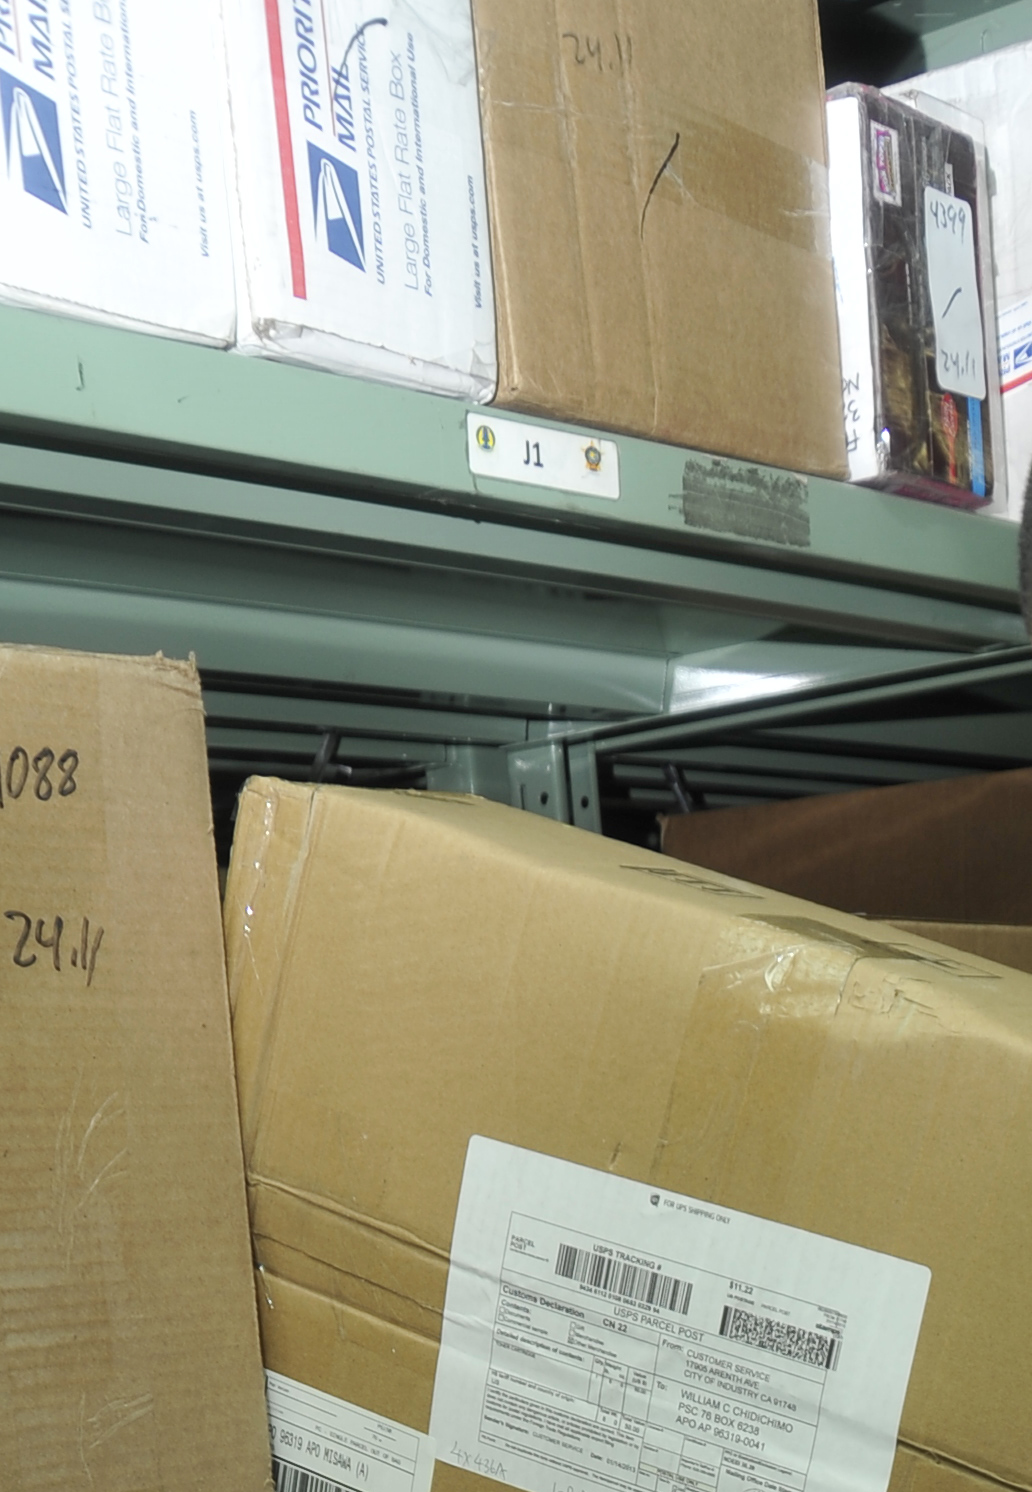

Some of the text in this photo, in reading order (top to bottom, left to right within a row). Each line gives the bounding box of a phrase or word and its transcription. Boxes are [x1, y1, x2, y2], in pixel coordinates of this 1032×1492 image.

[60, 19, 78, 91] POSTAL
[99, 33, 118, 97] Rate
[69, 92, 85, 159] STATES
[103, 105, 125, 153] Flat
[126, 98, 139, 131] and
[332, 62, 358, 153] MAIL
[364, 96, 375, 161] POSTAL
[131, 135, 146, 213] Domestic
[189, 109, 209, 258] Visit us at usps.com
[389, 50, 420, 292] Large Flat Rate Box
[407, 32, 433, 298] For Domestic and International Use
[76, 159, 92, 230] UNITED
[113, 162, 133, 238] Large
[368, 160, 380, 221] STATES
[467, 175, 483, 310] Visit us at usps.com
[929, 200, 966, 244] 4399
[373, 220, 385, 285] UNITED
[940, 349, 976, 381] 24.11
[523, 440, 544, 468] J1
[0, 746, 79, 806] 088
[664, 1199, 730, 1225] FOR UPS SHIPPING ONLY
[510, 1241, 527, 1251] POST
[511, 1234, 536, 1248] PARCEL
[593, 1243, 613, 1256] USPS
[616, 1251, 655, 1269] TRACKING
[502, 1284, 628, 1333] Customs Declaration CN 22
[729, 1280, 754, 1295] $11.22
[613, 1306, 704, 1343] USPS PARCEL POST
[662, 1339, 684, 1353] From:
[656, 1380, 668, 1392] To:
[684, 1369, 702, 1382] CITY
[704, 1375, 716, 1386] OF
[717, 1380, 758, 1400] INDUSTRY
[760, 1394, 772, 1404] CA
[686, 1348, 771, 1383] CUSTOMER SERVICE
[709, 1367, 743, 1385] ARENTH
[744, 1378, 760, 1390] AVE
[678, 1402, 698, 1417] PSC
[714, 1414, 735, 1428] BOX
[680, 1388, 721, 1410] WILLIAM
[722, 1402, 731, 1413] C
[279, 1428, 370, 1482] 96319 APO MISAWA (A)
[676, 1415, 696, 1429] APO
[698, 1422, 711, 1434] AP
[713, 1427, 765, 1451] 96319-0041
